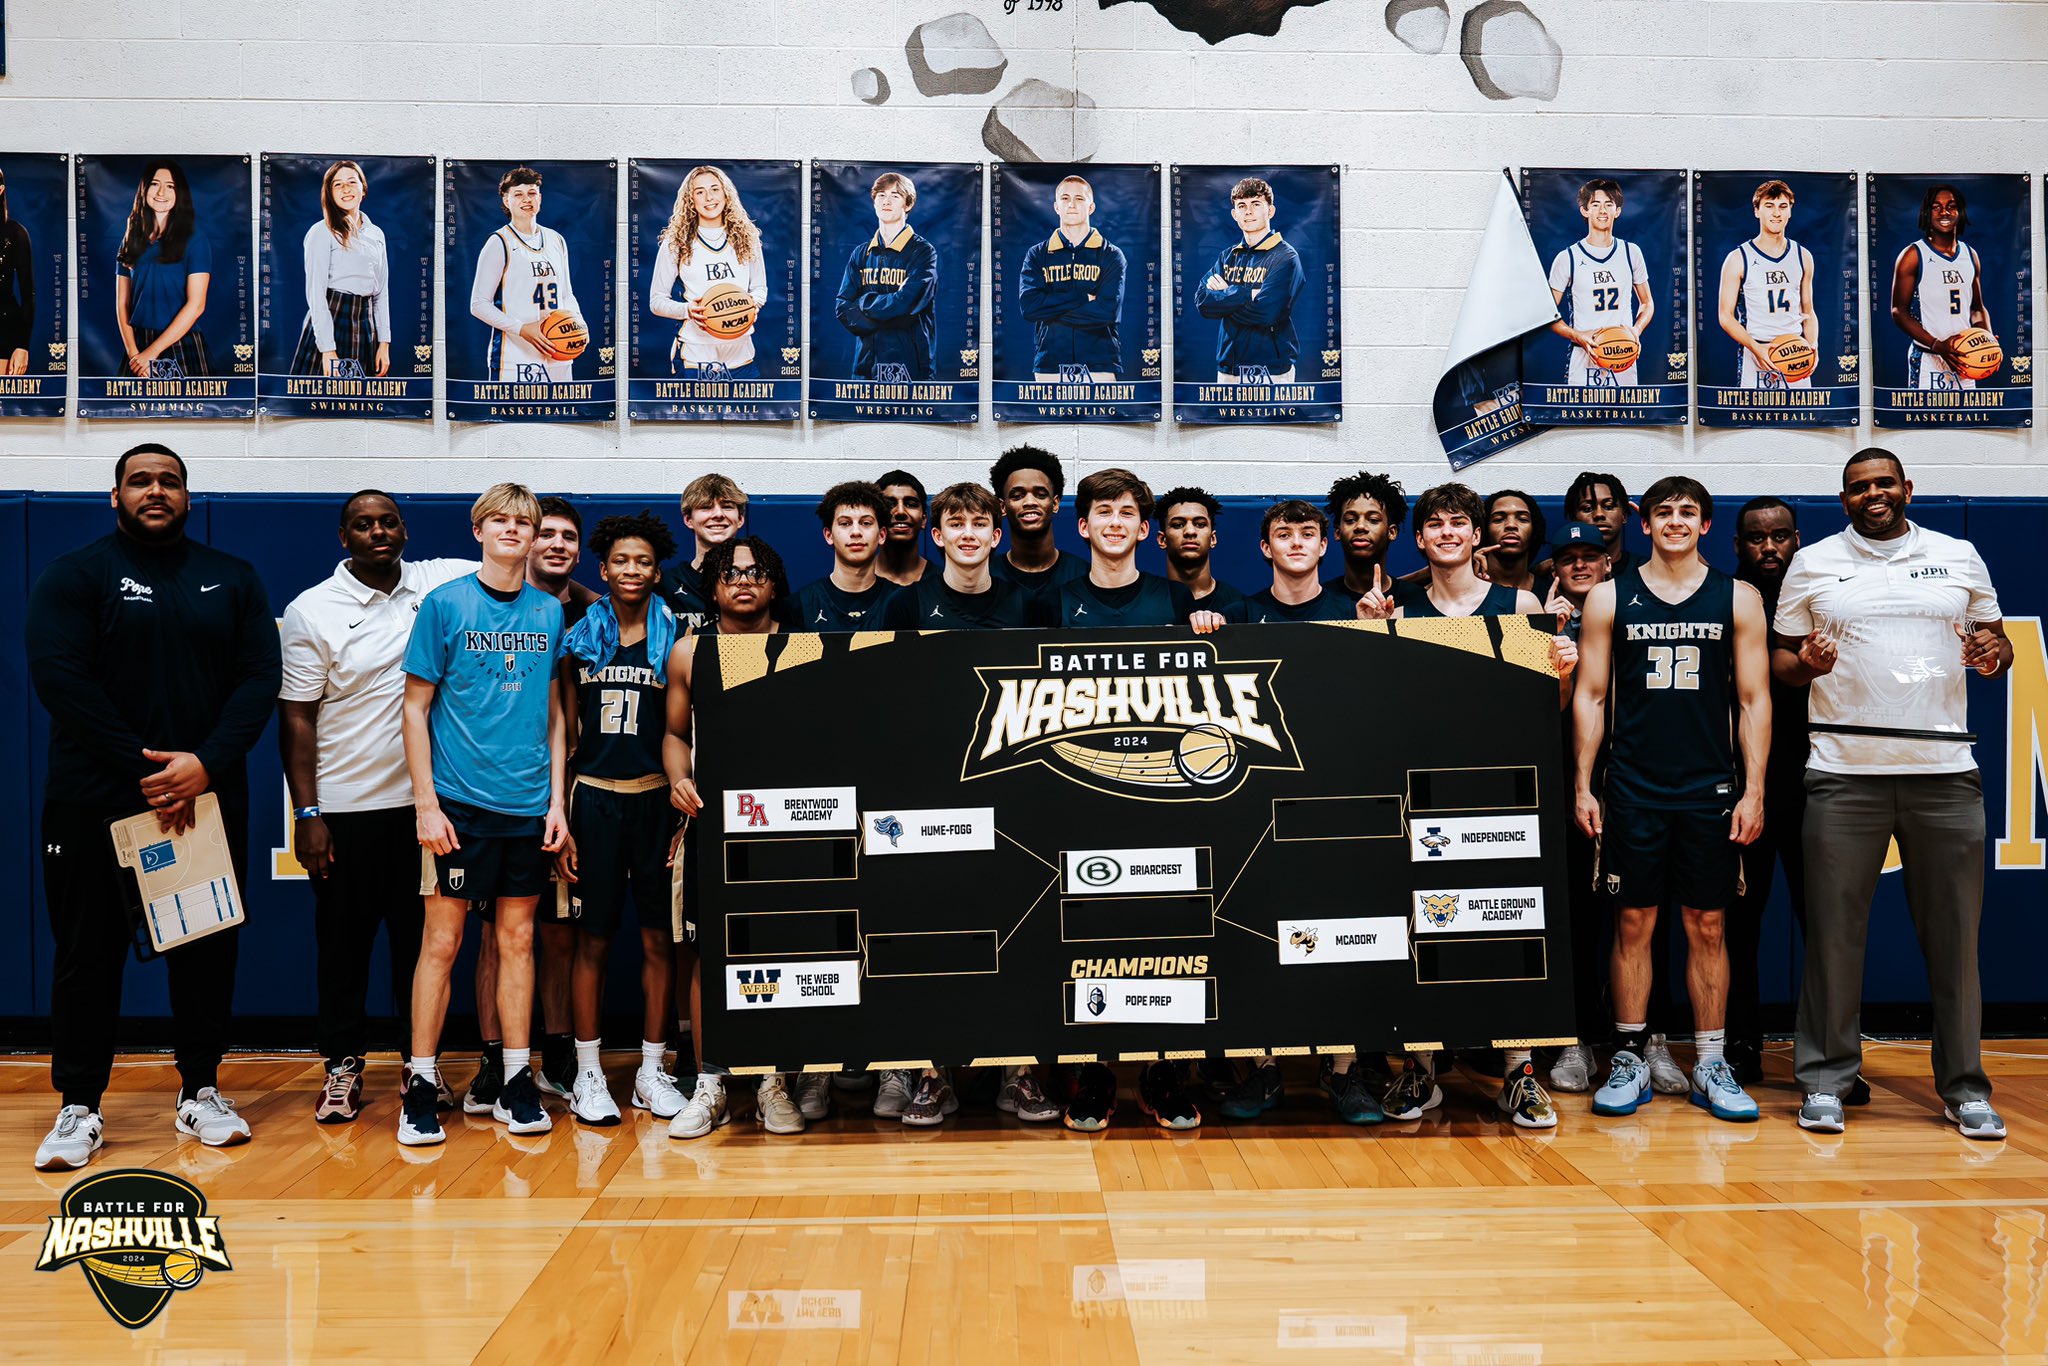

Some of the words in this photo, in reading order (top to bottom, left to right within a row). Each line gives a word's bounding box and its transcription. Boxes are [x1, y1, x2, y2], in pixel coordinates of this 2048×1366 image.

[813, 171, 822, 213] JACK
[53, 254, 62, 341] WILDCATS
[236, 256, 247, 343] WILDCATS
[420, 258, 429, 344] WILDCATS
[532, 283, 559, 310] 43
[603, 260, 612, 345] WILDCATS
[786, 260, 795, 346] WILDCATS
[1593, 288, 1619, 312] 32
[1767, 289, 1790, 314] 14
[1949, 289, 1961, 316] 5
[711, 297, 750, 314] Wilson
[966, 263, 975, 348] WILDCATS
[1146, 263, 1155, 348] WILDCATS
[1325, 263, 1335, 349] WILDCATS
[1672, 267, 1682, 351] WILDCATS
[1842, 271, 1852, 354] WILDCATS
[2015, 271, 2025, 355] WILDCATS
[721, 316, 749, 329] NCAA
[1603, 345, 1634, 356] Wilson
[1778, 344, 1811, 358] Wilson
[48, 361, 67, 371] 2025
[234, 363, 254, 373] 2025
[414, 363, 432, 373] 2025
[598, 366, 615, 376] 2025
[781, 366, 800, 376] 2025
[960, 368, 978, 377] 2025
[1142, 367, 1160, 377] 2025
[1787, 360, 1810, 371] NCAA
[1321, 368, 1341, 378] 2025
[1667, 371, 1687, 380] 2025
[1838, 374, 1858, 383] 2025
[2011, 374, 2031, 384] 2025
[0, 379, 41, 394] ACADEMY
[106, 381, 142, 396] BATTLE
[146, 381, 182, 396] GROUND
[186, 381, 228, 396] ACADEMY
[287, 380, 323, 395] BATTLE
[326, 380, 362, 396] GROUND
[366, 381, 408, 397] ACADEMY
[473, 384, 511, 400] BATTLE
[513, 384, 549, 400] GROUND
[552, 384, 593, 400] ACADEMY
[656, 383, 692, 399] BATTLE
[694, 383, 730, 399] GROUND
[733, 383, 774, 399] ACADEMY
[835, 384, 872, 399] BATTLE
[874, 384, 909, 400] GROUND
[912, 385, 953, 401] ACADEMY
[1018, 385, 1054, 400] BATTLE
[1056, 385, 1091, 401] GROUND
[1094, 385, 1136, 401] ACADEMY
[1199, 386, 1235, 401] BATTLE
[1236, 386, 1272, 402] GROUND
[1274, 386, 1315, 401] ACADEMY
[1546, 388, 1580, 403] BATTLE
[1582, 388, 1617, 404] GROUND
[1619, 388, 1660, 403] ACADEMY
[1717, 391, 1750, 405] BATTLE
[1752, 391, 1787, 406] GROUND
[1788, 391, 1831, 406] ACADEMY
[1891, 391, 1924, 407] BATTLE
[1926, 391, 1960, 407] GROUND
[1963, 391, 2004, 407] ACADEMY
[130, 402, 204, 412] SWIMMING
[311, 401, 384, 412] SWIMMING
[490, 405, 579, 416] BASKETBALL
[672, 404, 760, 414] BASKETBALL
[856, 405, 934, 416] WRESTLING
[1038, 406, 1116, 417] WRESTLING
[1219, 406, 1296, 417] WRESTLING
[1562, 409, 1645, 419] BASKETBALL
[1732, 412, 1816, 421] BASKETBALL
[1906, 412, 1989, 422] BASKETBALL
[1464, 413, 1500, 440] BATTLE
[120, 577, 153, 595] Pope
[1626, 622, 1724, 640] KNIGHTS
[465, 631, 548, 652] KNIGHTS
[1050, 653, 1146, 672] BATTLE
[1159, 651, 1207, 669] FOR
[1646, 645, 1700, 690] 32
[600, 689, 640, 736] 21
[980, 673, 1283, 761] NASHVILLE
[1113, 736, 1149, 747] 2024
[784, 798, 839, 811] BRENTWOOD
[790, 810, 833, 822] ACADEMY
[920, 824, 972, 837] HUME-FOGG
[1461, 830, 1527, 844] INDEPENDENCE
[1130, 863, 1183, 876] BRIARCREST
[1468, 898, 1500, 911] BATTLE
[1500, 897, 1536, 910] GROUND
[1481, 909, 1523, 922] ACADEMY
[1335, 933, 1378, 946] MCADORY
[1070, 955, 1209, 979] CHAMPIONS
[795, 974, 813, 985] THE
[813, 973, 840, 985] WEBB
[742, 984, 776, 994] WEBB
[800, 985, 836, 997] SCHOOL
[1125, 995, 1148, 1006] POPE
[1149, 995, 1172, 1006] PREP
